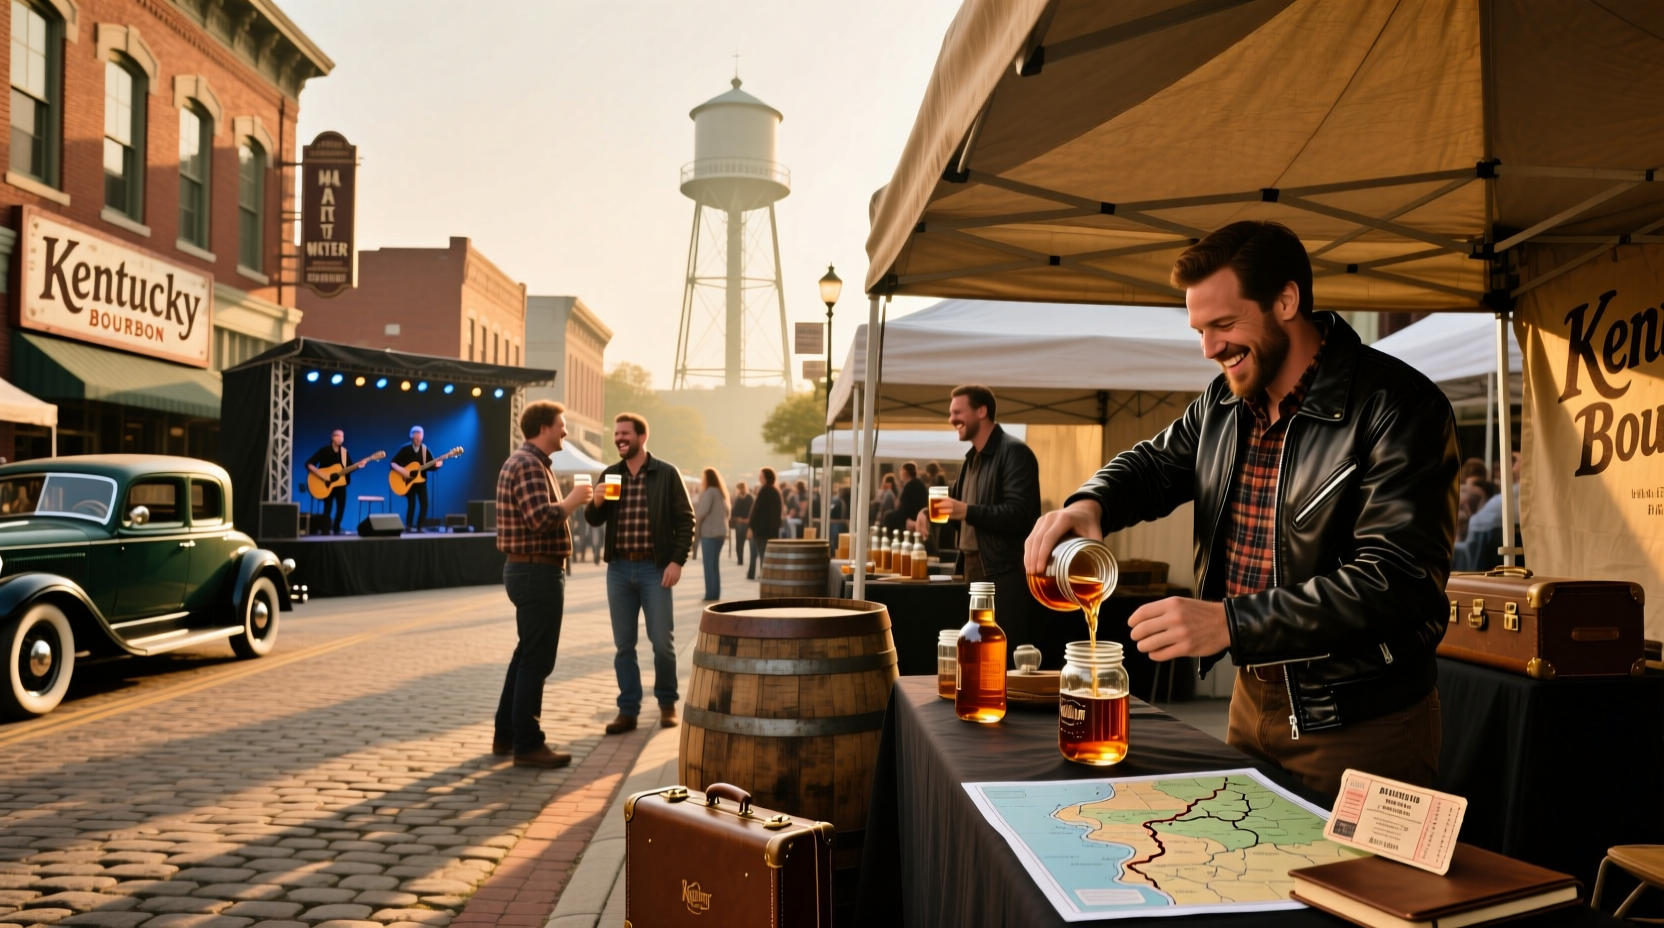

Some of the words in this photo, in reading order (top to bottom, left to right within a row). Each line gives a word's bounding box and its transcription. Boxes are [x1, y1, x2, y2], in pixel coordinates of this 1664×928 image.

[39, 236, 201, 341] Kentucky
[89, 308, 164, 343] BOURBON
[1558, 289, 1664, 404] Ken
[1574, 401, 1664, 477] Bou
